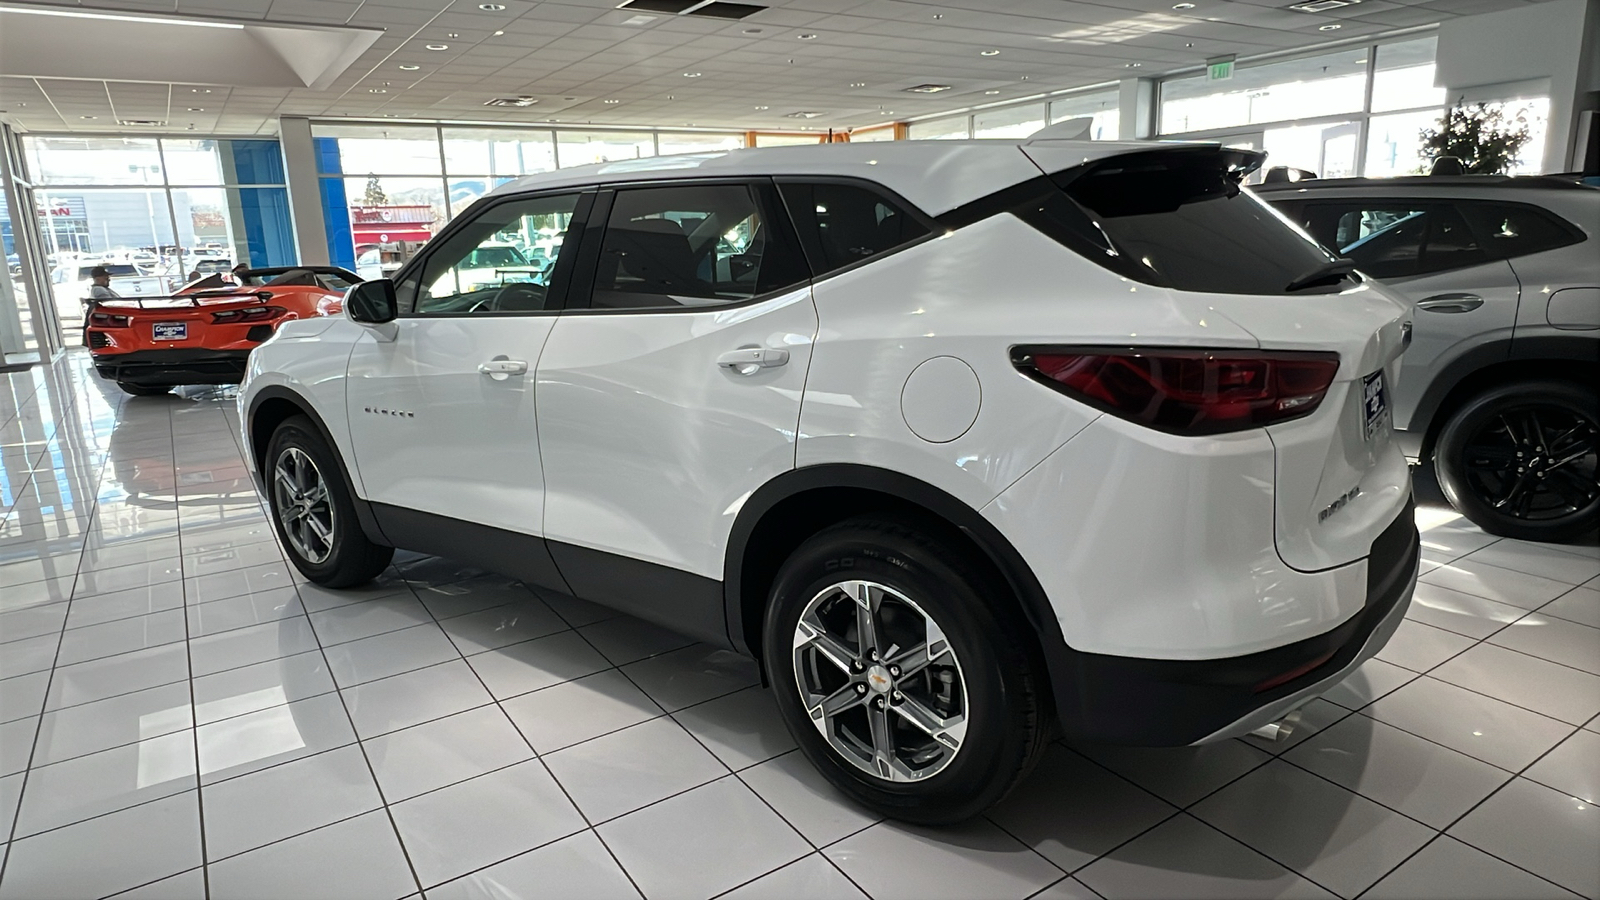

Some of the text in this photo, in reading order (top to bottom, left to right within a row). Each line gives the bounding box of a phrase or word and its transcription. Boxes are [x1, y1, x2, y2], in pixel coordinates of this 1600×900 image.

[1211, 62, 1230, 80] EXIT
[155, 325, 185, 333] CHAMPION
[364, 406, 415, 418] BLAZER
